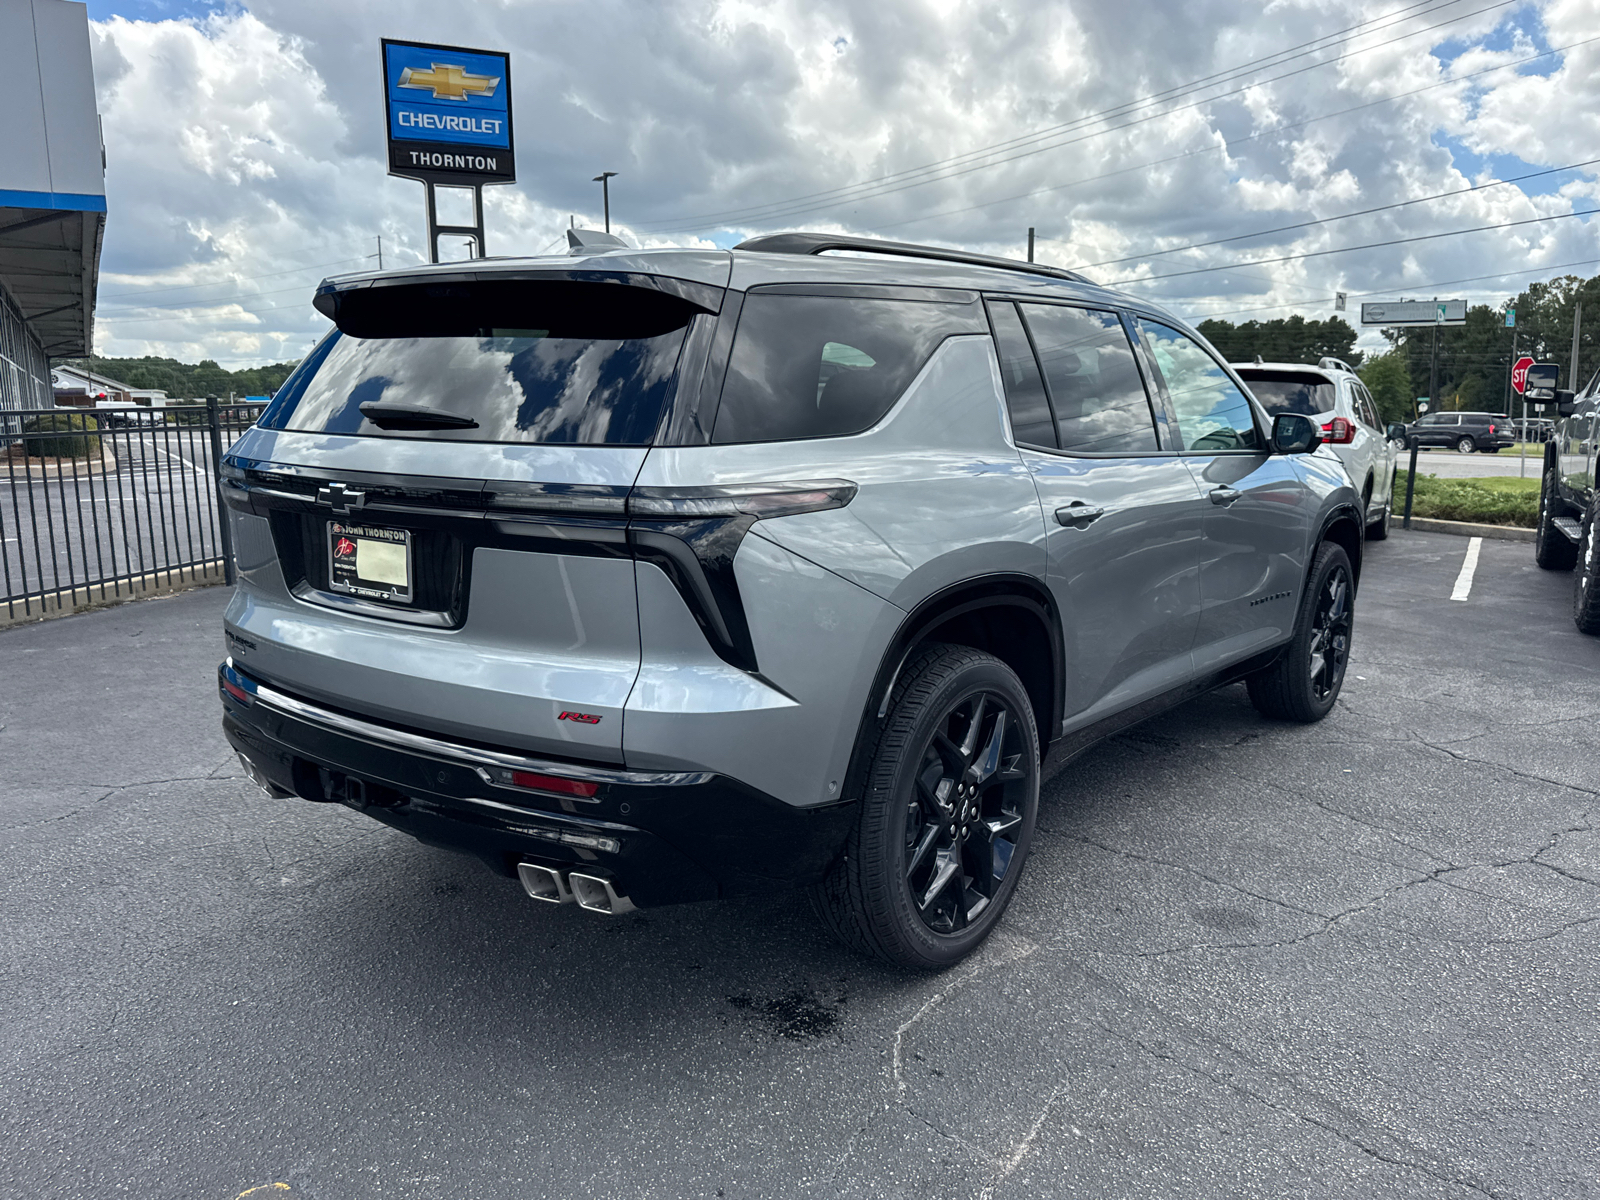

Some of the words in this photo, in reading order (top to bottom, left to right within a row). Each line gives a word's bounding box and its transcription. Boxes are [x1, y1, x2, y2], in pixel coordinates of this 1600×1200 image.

[398, 111, 502, 134] CHEVROLET
[410, 151, 497, 170] THORNTON
[345, 525, 364, 536] JOHN
[364, 528, 405, 541] THORNTON
[357, 589, 381, 598] CHEVROLET
[557, 710, 603, 725] RS
